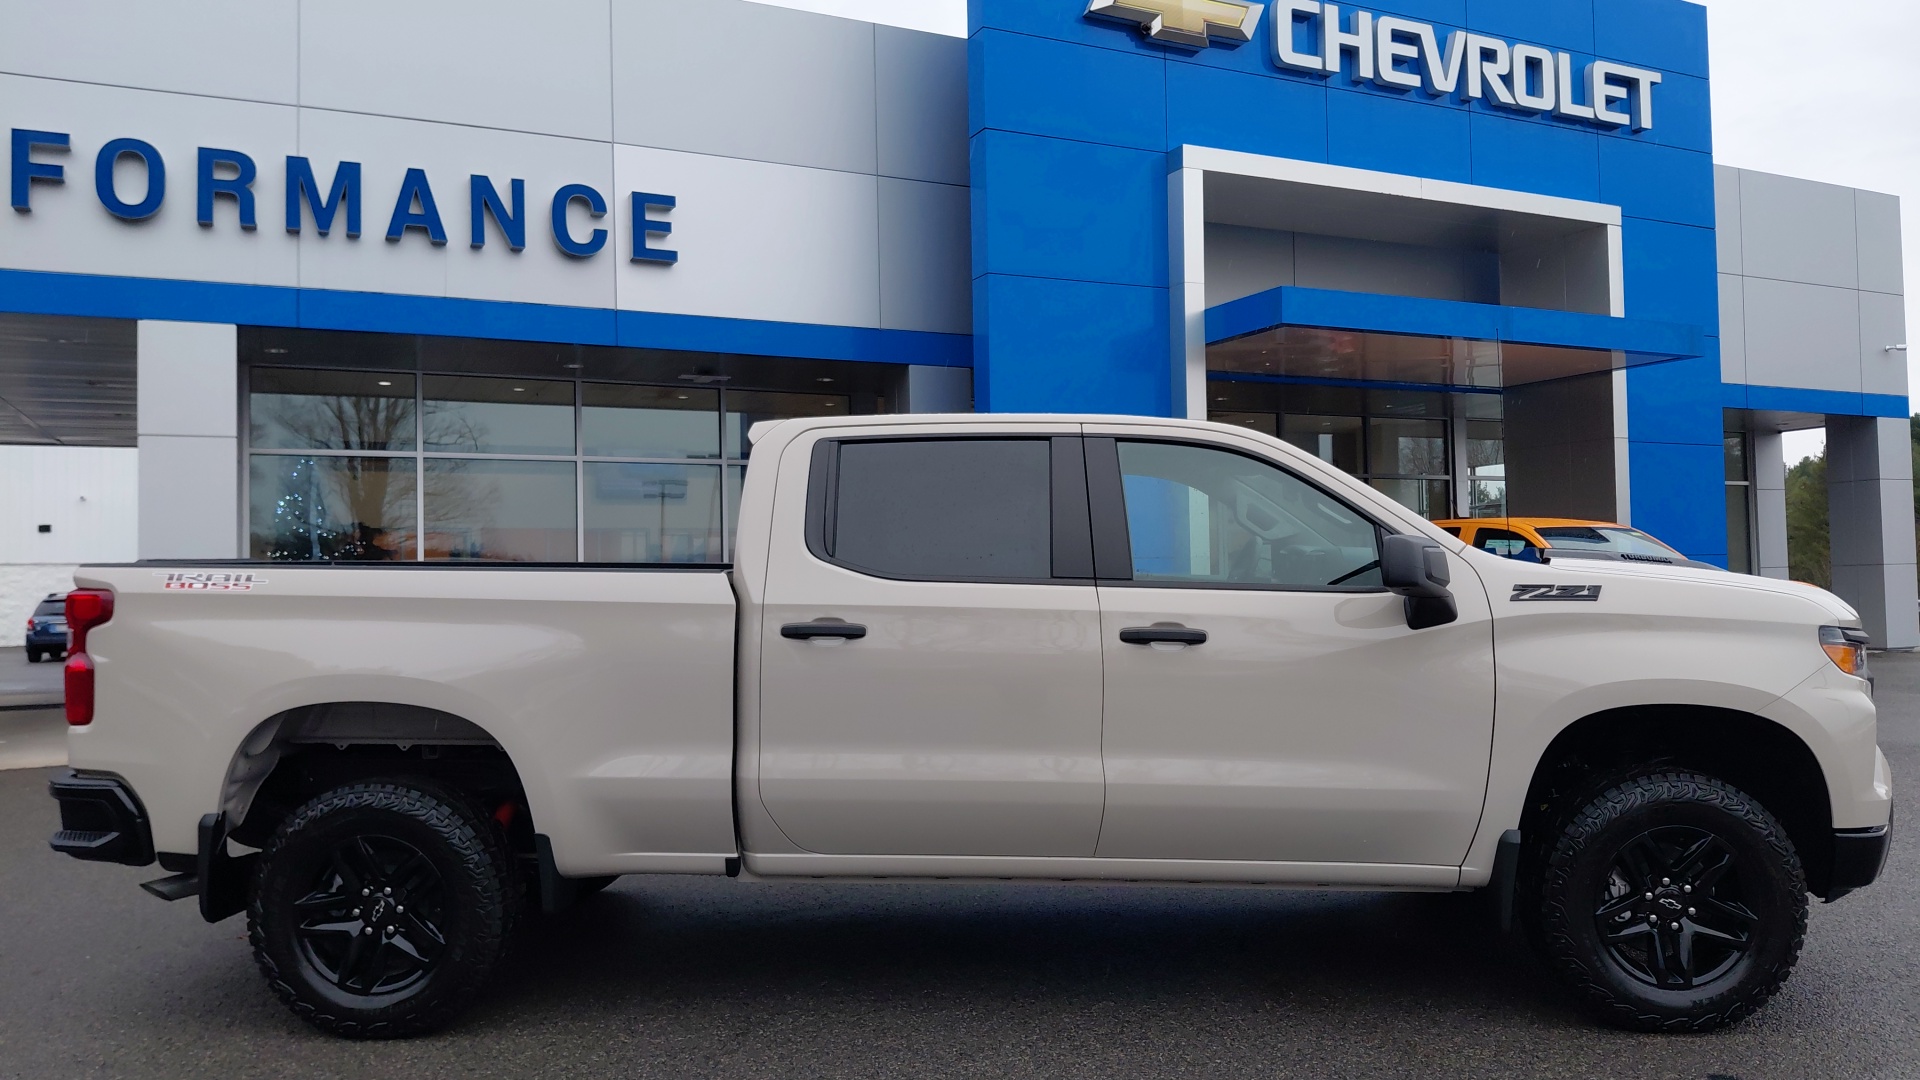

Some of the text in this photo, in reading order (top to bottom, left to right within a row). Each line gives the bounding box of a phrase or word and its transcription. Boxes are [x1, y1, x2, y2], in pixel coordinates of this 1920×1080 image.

[1271, 0, 1661, 130] CHEVROLET
[11, 128, 678, 264] FORMANCE
[153, 572, 268, 583] TRAIL
[164, 582, 252, 591] BOSS
[1509, 584, 1602, 602] Z71
